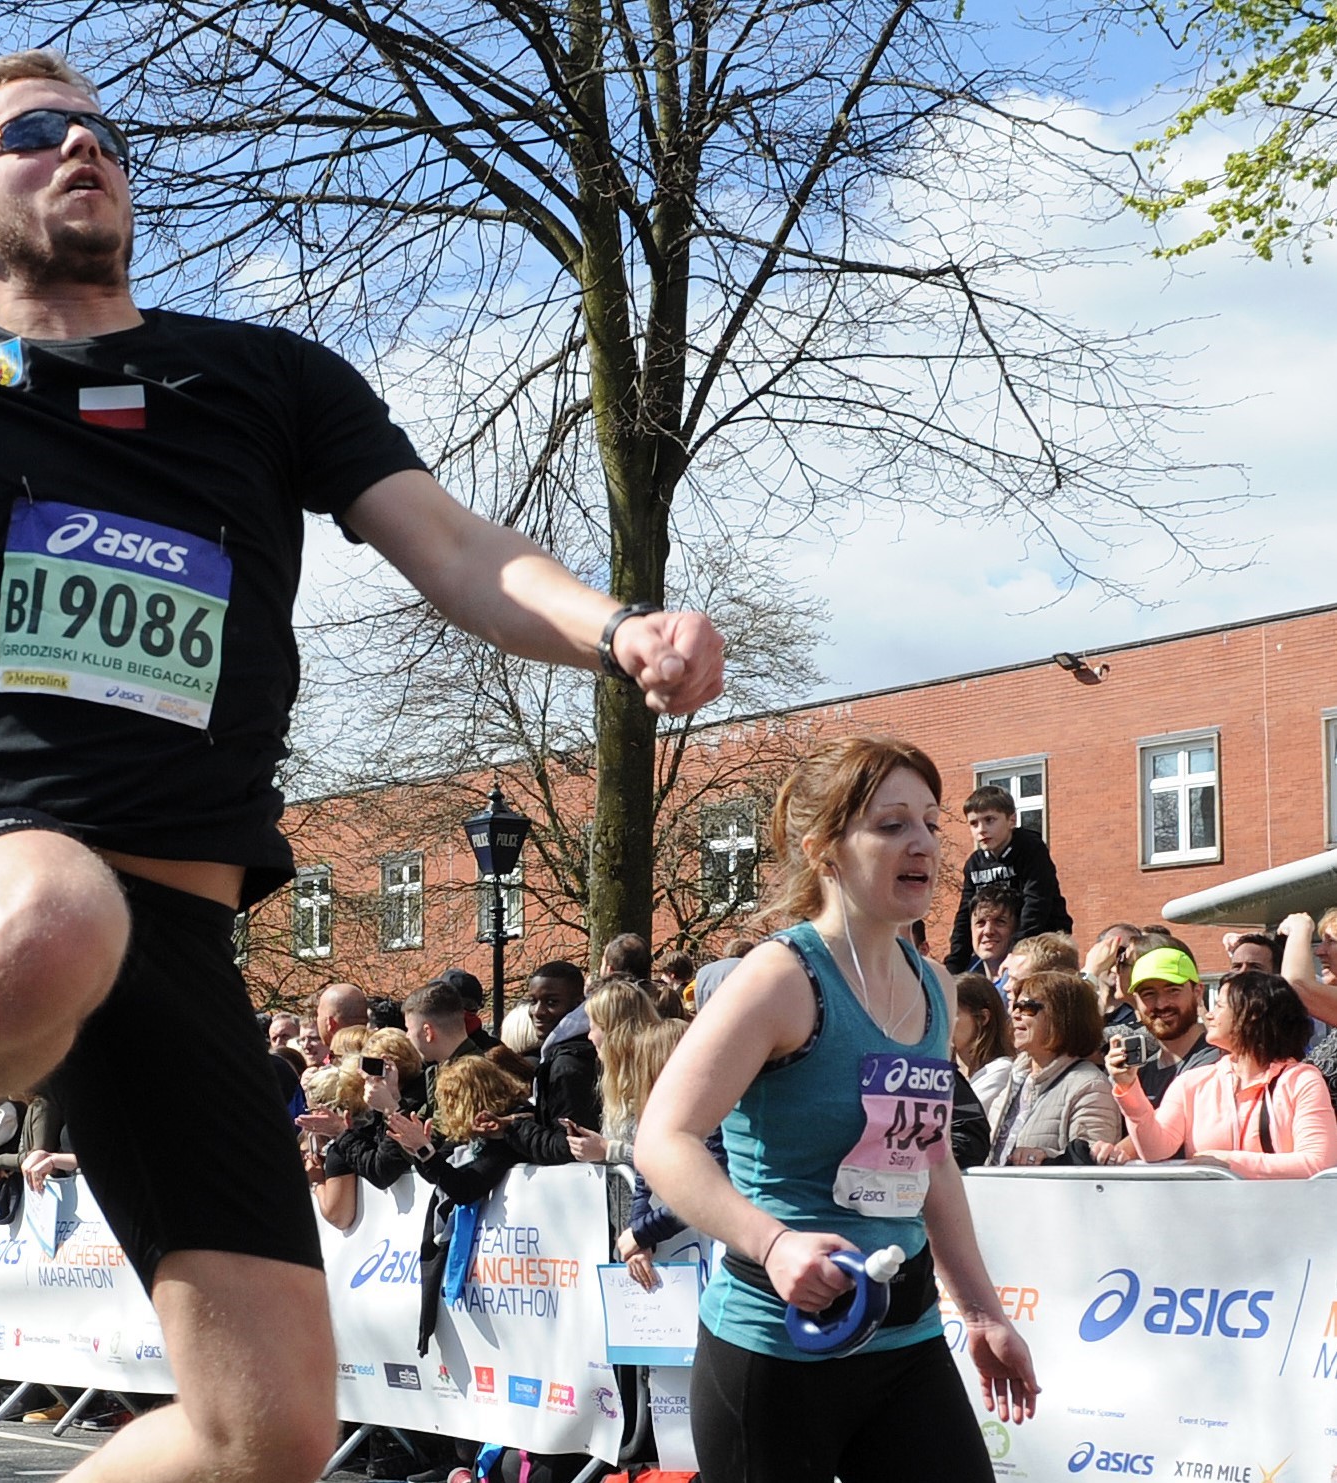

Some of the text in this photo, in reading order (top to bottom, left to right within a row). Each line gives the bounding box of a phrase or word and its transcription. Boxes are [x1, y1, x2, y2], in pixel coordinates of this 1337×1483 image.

[93, 527, 189, 574] asics
[3, 643, 213, 694] GRODZISKI KLUB BIEGACZA 2
[14, 672, 68, 689] Metrolink
[471, 832, 491, 848] POLICE
[496, 832, 519, 848] POLICE
[907, 1066, 953, 1092] asics
[474, 1226, 540, 1255] REATER
[38, 1266, 114, 1289] MARATHON
[379, 1250, 423, 1285] asic
[465, 1257, 580, 1288] ANCHESTER
[1143, 1286, 1275, 1339] asics
[653, 1396, 687, 1405] ANCER
[653, 1406, 690, 1414] ESEARC
[1178, 1416, 1199, 1426] Event
[1095, 1450, 1155, 1476] asics
[1173, 1460, 1252, 1483] XTRA MILE
